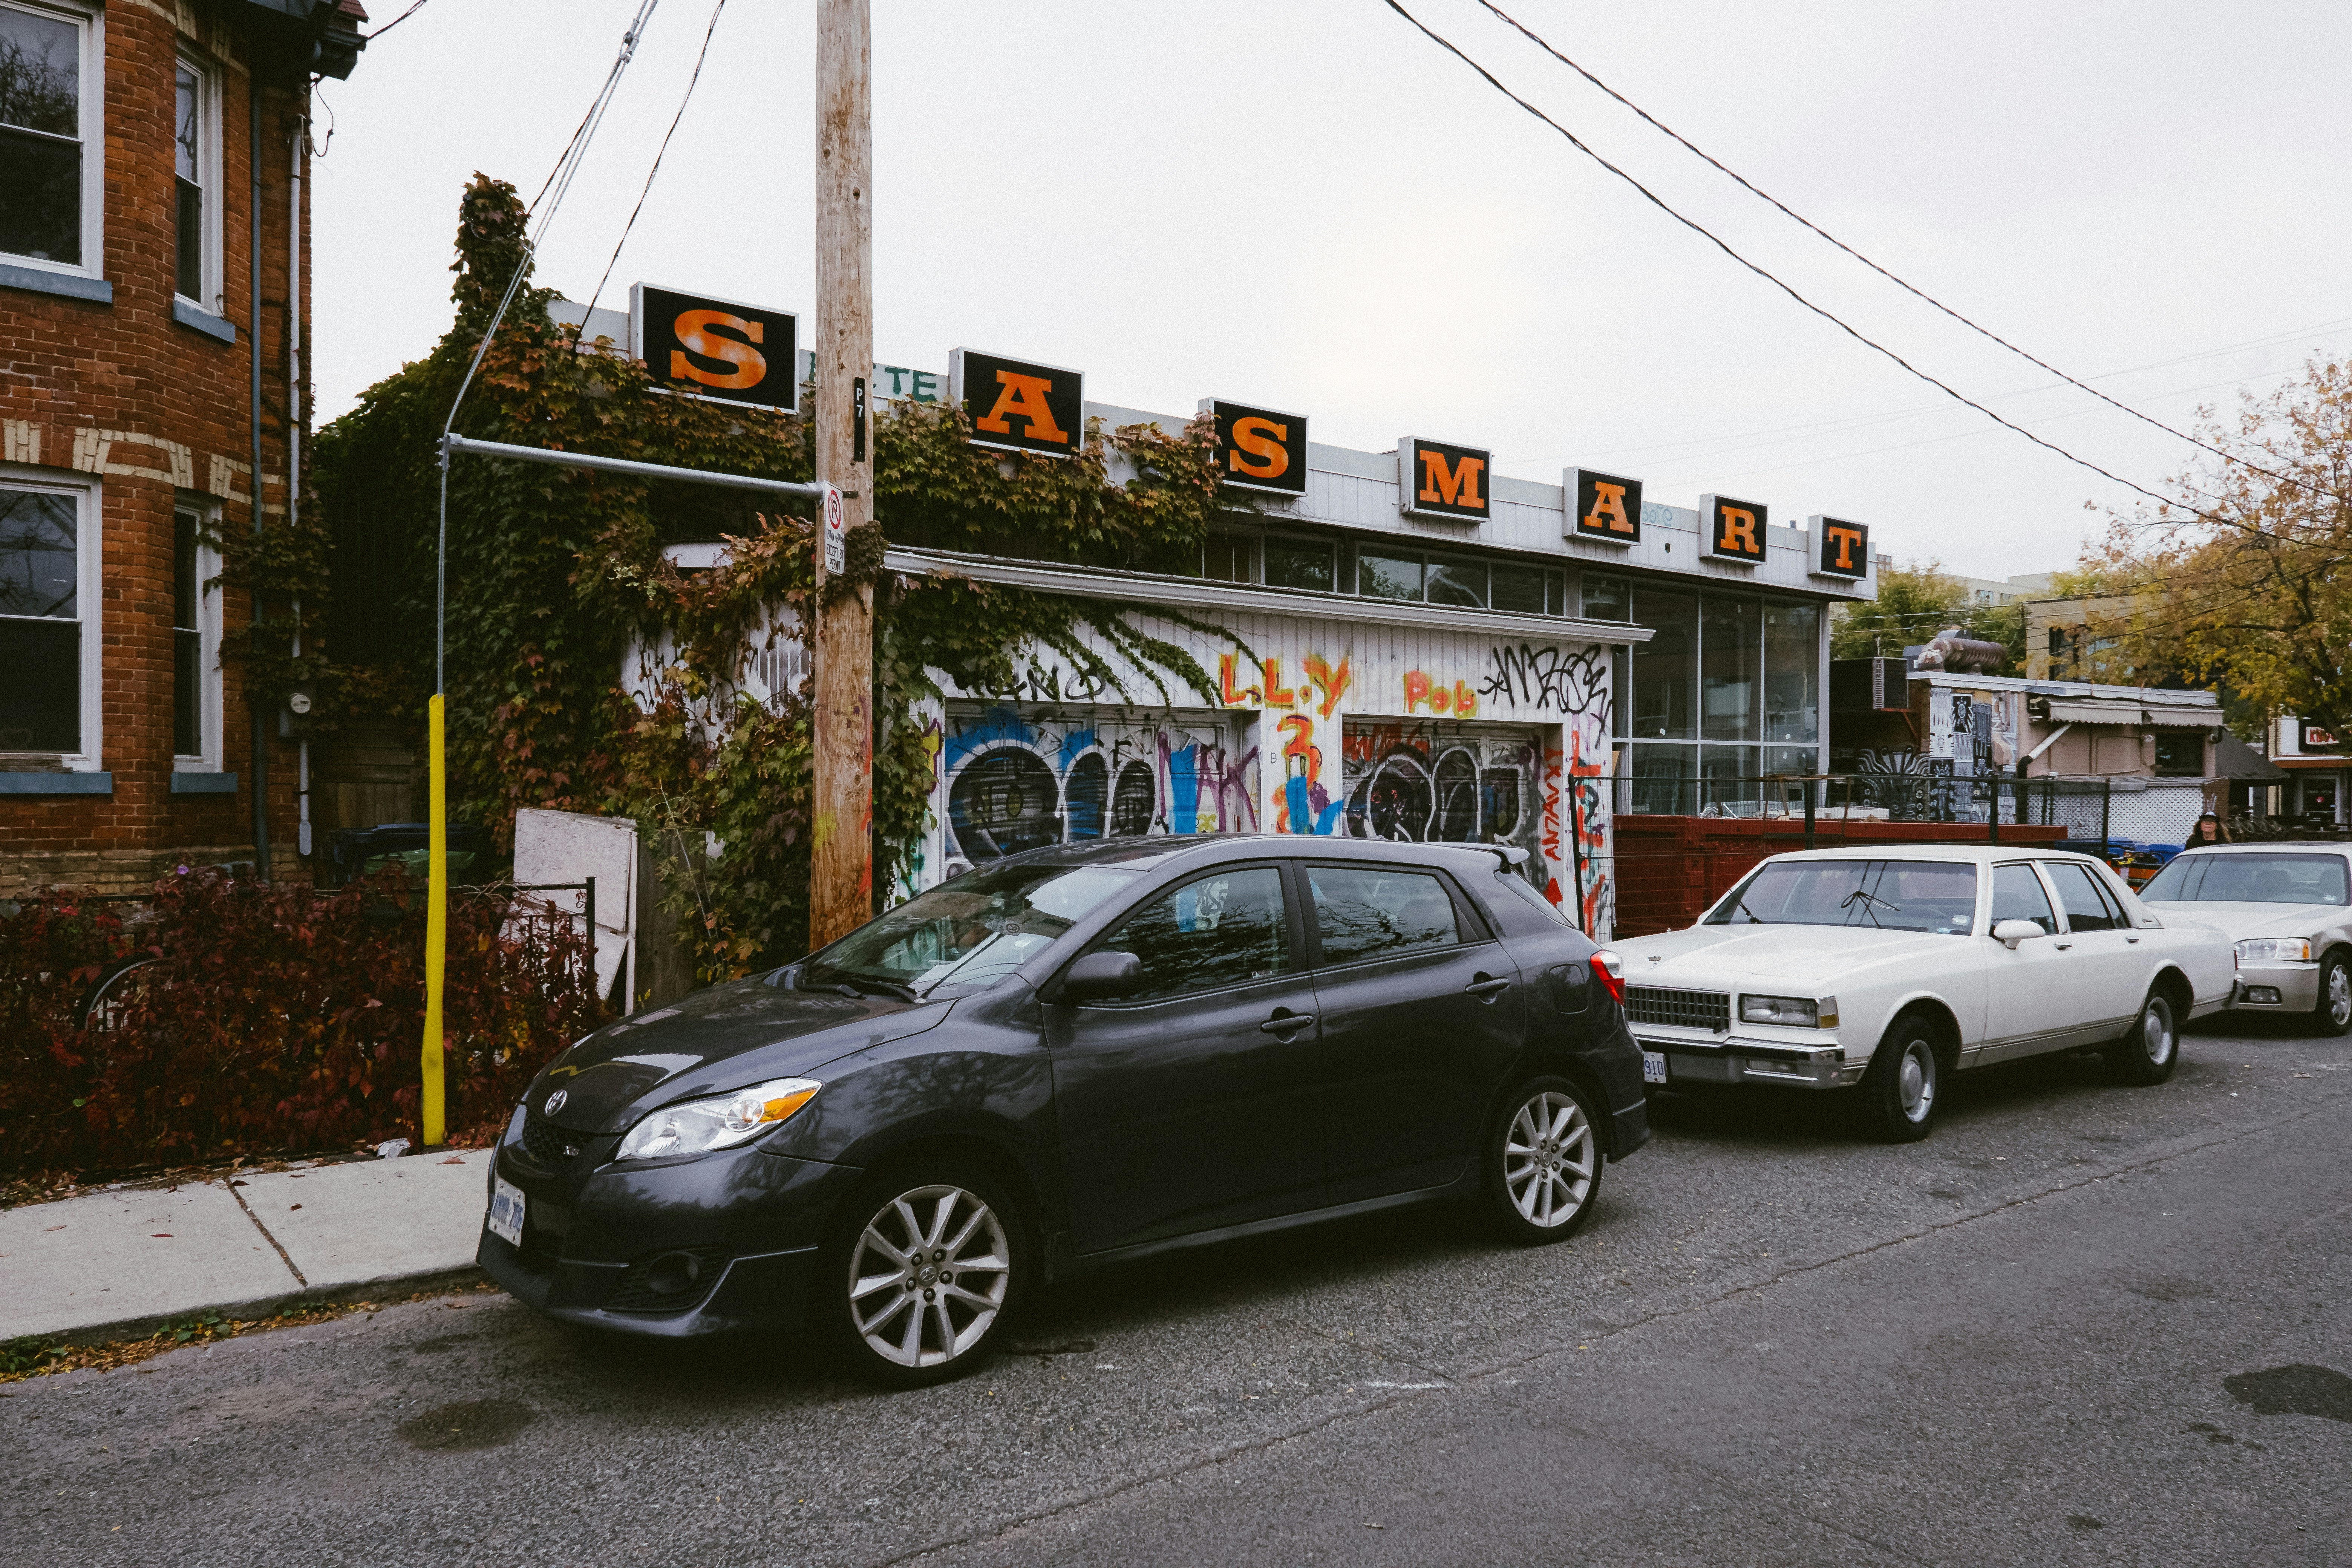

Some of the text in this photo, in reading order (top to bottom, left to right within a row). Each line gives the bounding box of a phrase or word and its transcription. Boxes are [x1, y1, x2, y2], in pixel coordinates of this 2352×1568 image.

[827, 544, 844, 559] EXCEPT BY
[830, 558, 841, 571] PERMIT
